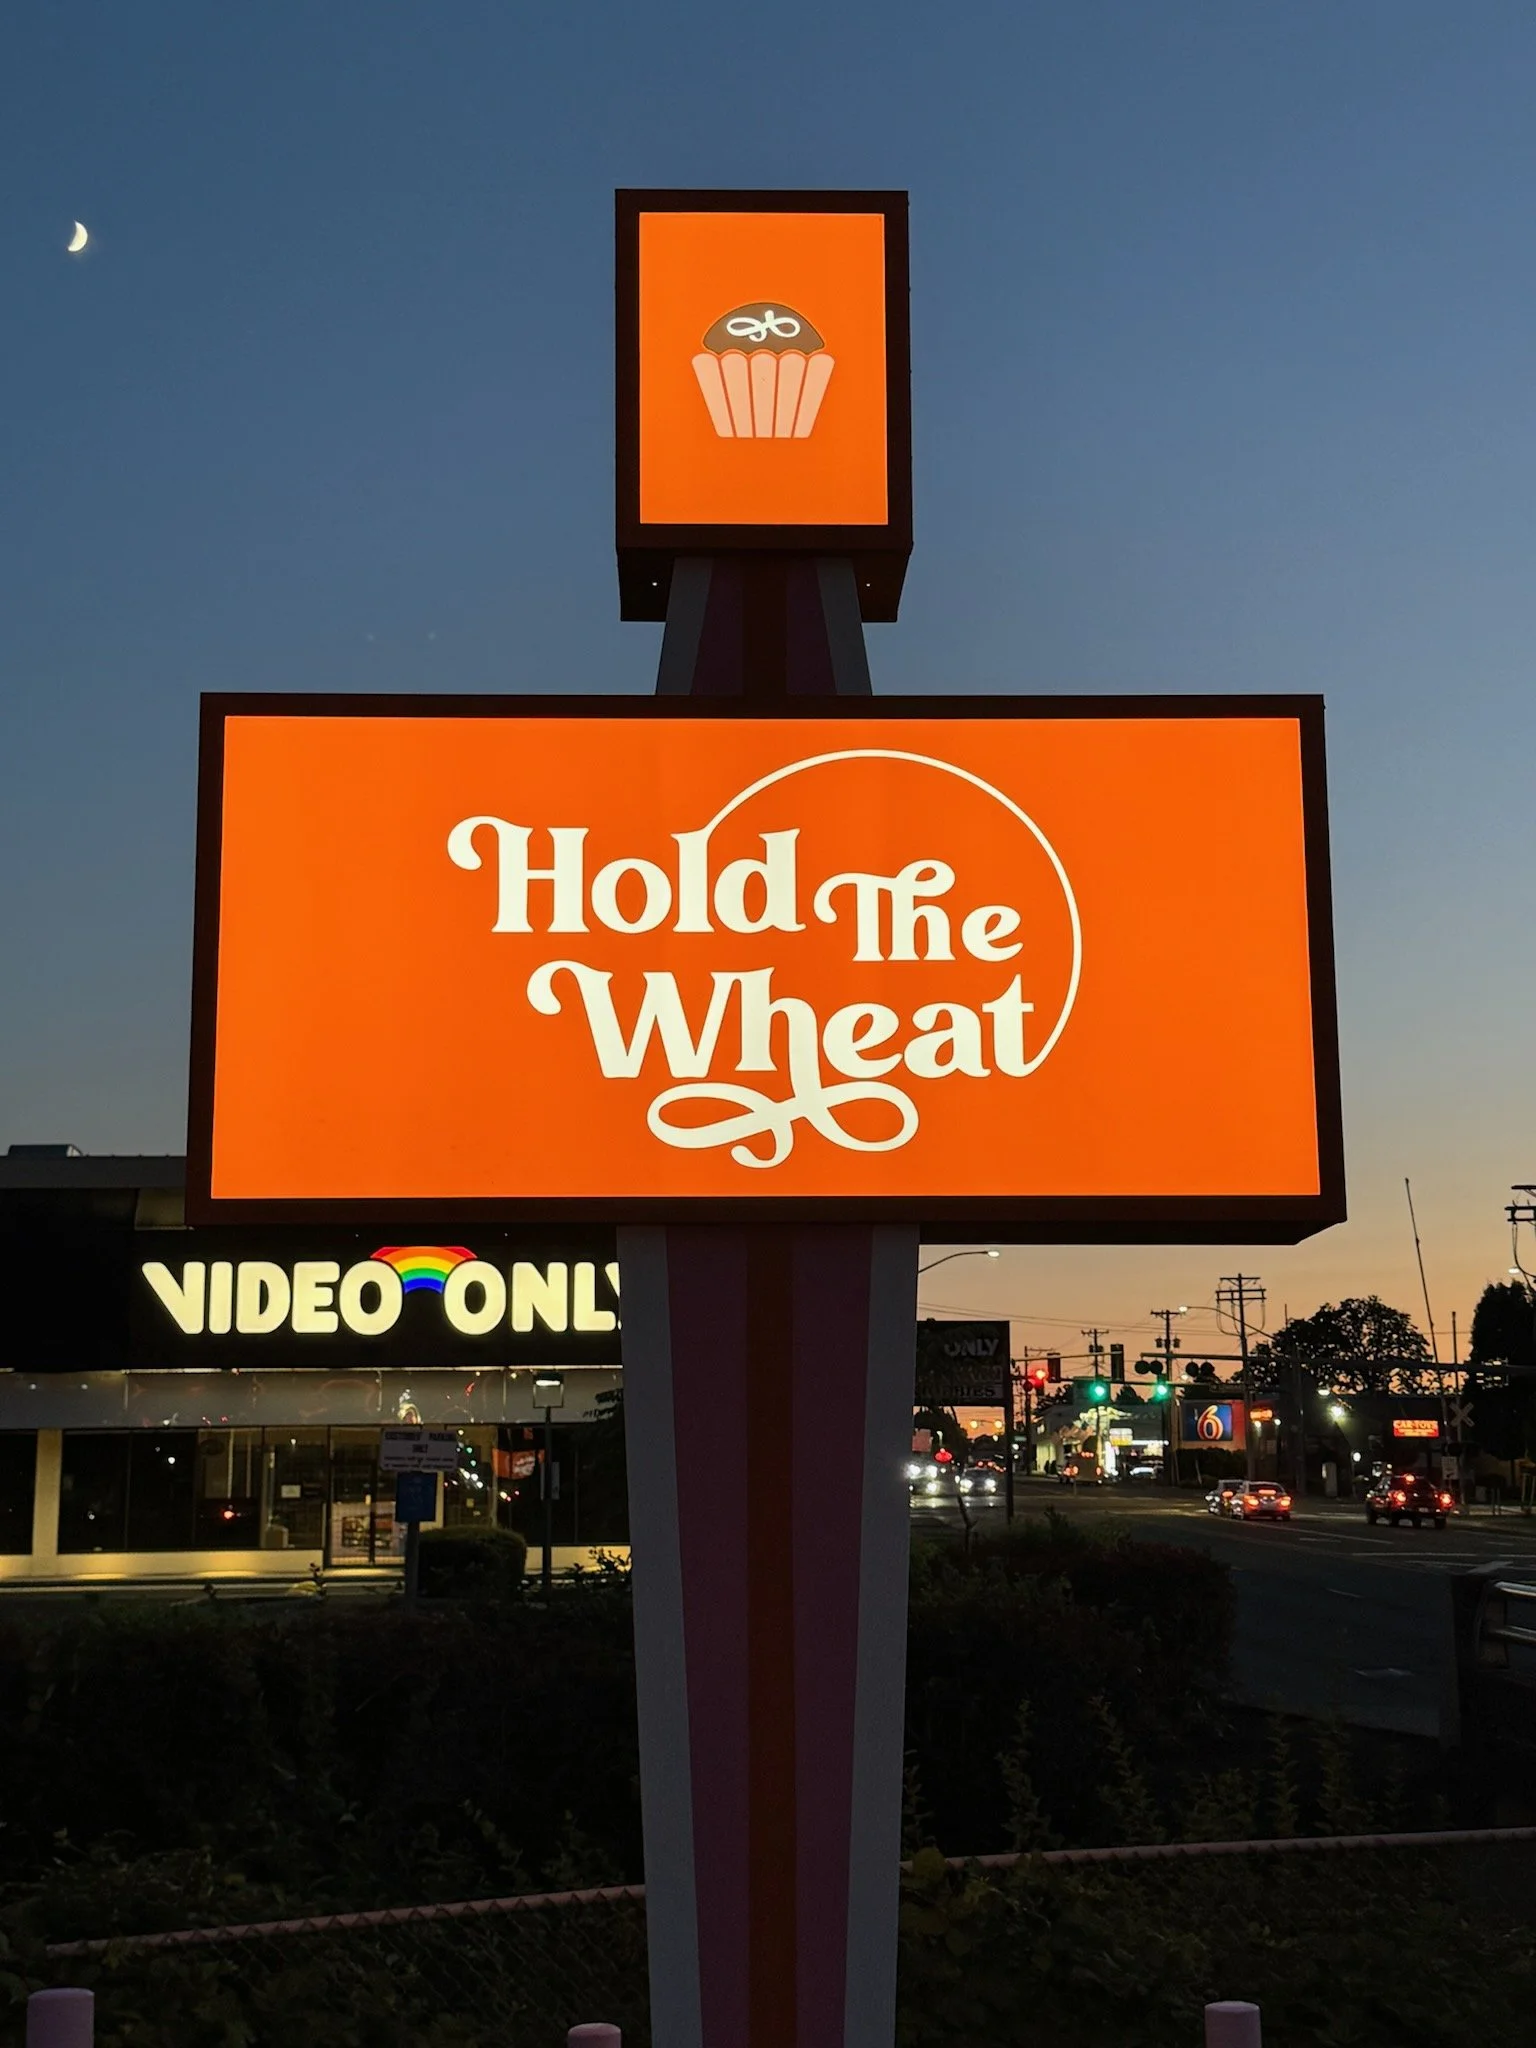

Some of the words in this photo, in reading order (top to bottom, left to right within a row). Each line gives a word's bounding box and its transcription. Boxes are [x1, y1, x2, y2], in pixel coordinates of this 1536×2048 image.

[447, 816, 806, 933] Hold
[813, 859, 1023, 961] The
[526, 959, 1034, 1168] Wheat
[141, 1261, 403, 1336] VIDEO
[444, 1261, 621, 1336] ONL
[944, 1338, 999, 1356] ONLY
[1197, 1405, 1224, 1440] 6
